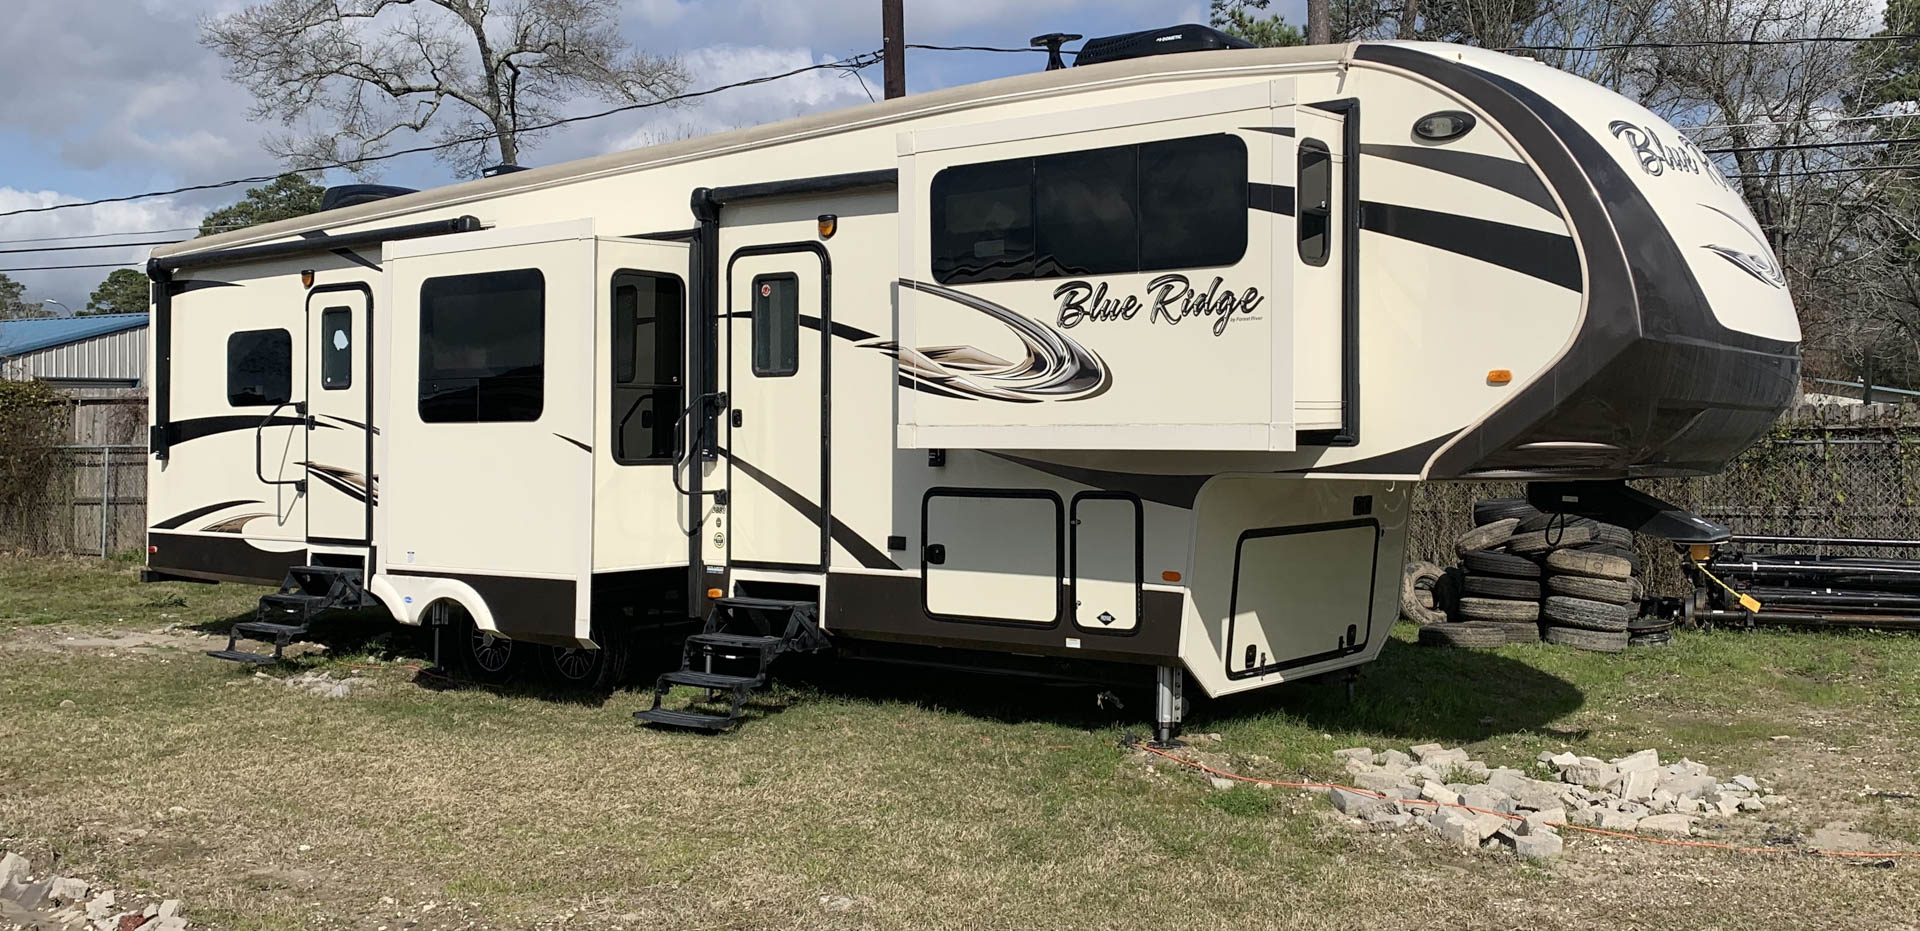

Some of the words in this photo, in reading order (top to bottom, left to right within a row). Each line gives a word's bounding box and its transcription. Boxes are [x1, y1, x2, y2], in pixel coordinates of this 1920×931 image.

[1608, 120, 1700, 176] Blue
[1053, 280, 1143, 329] Blue
[1147, 273, 1265, 337] Ridge
